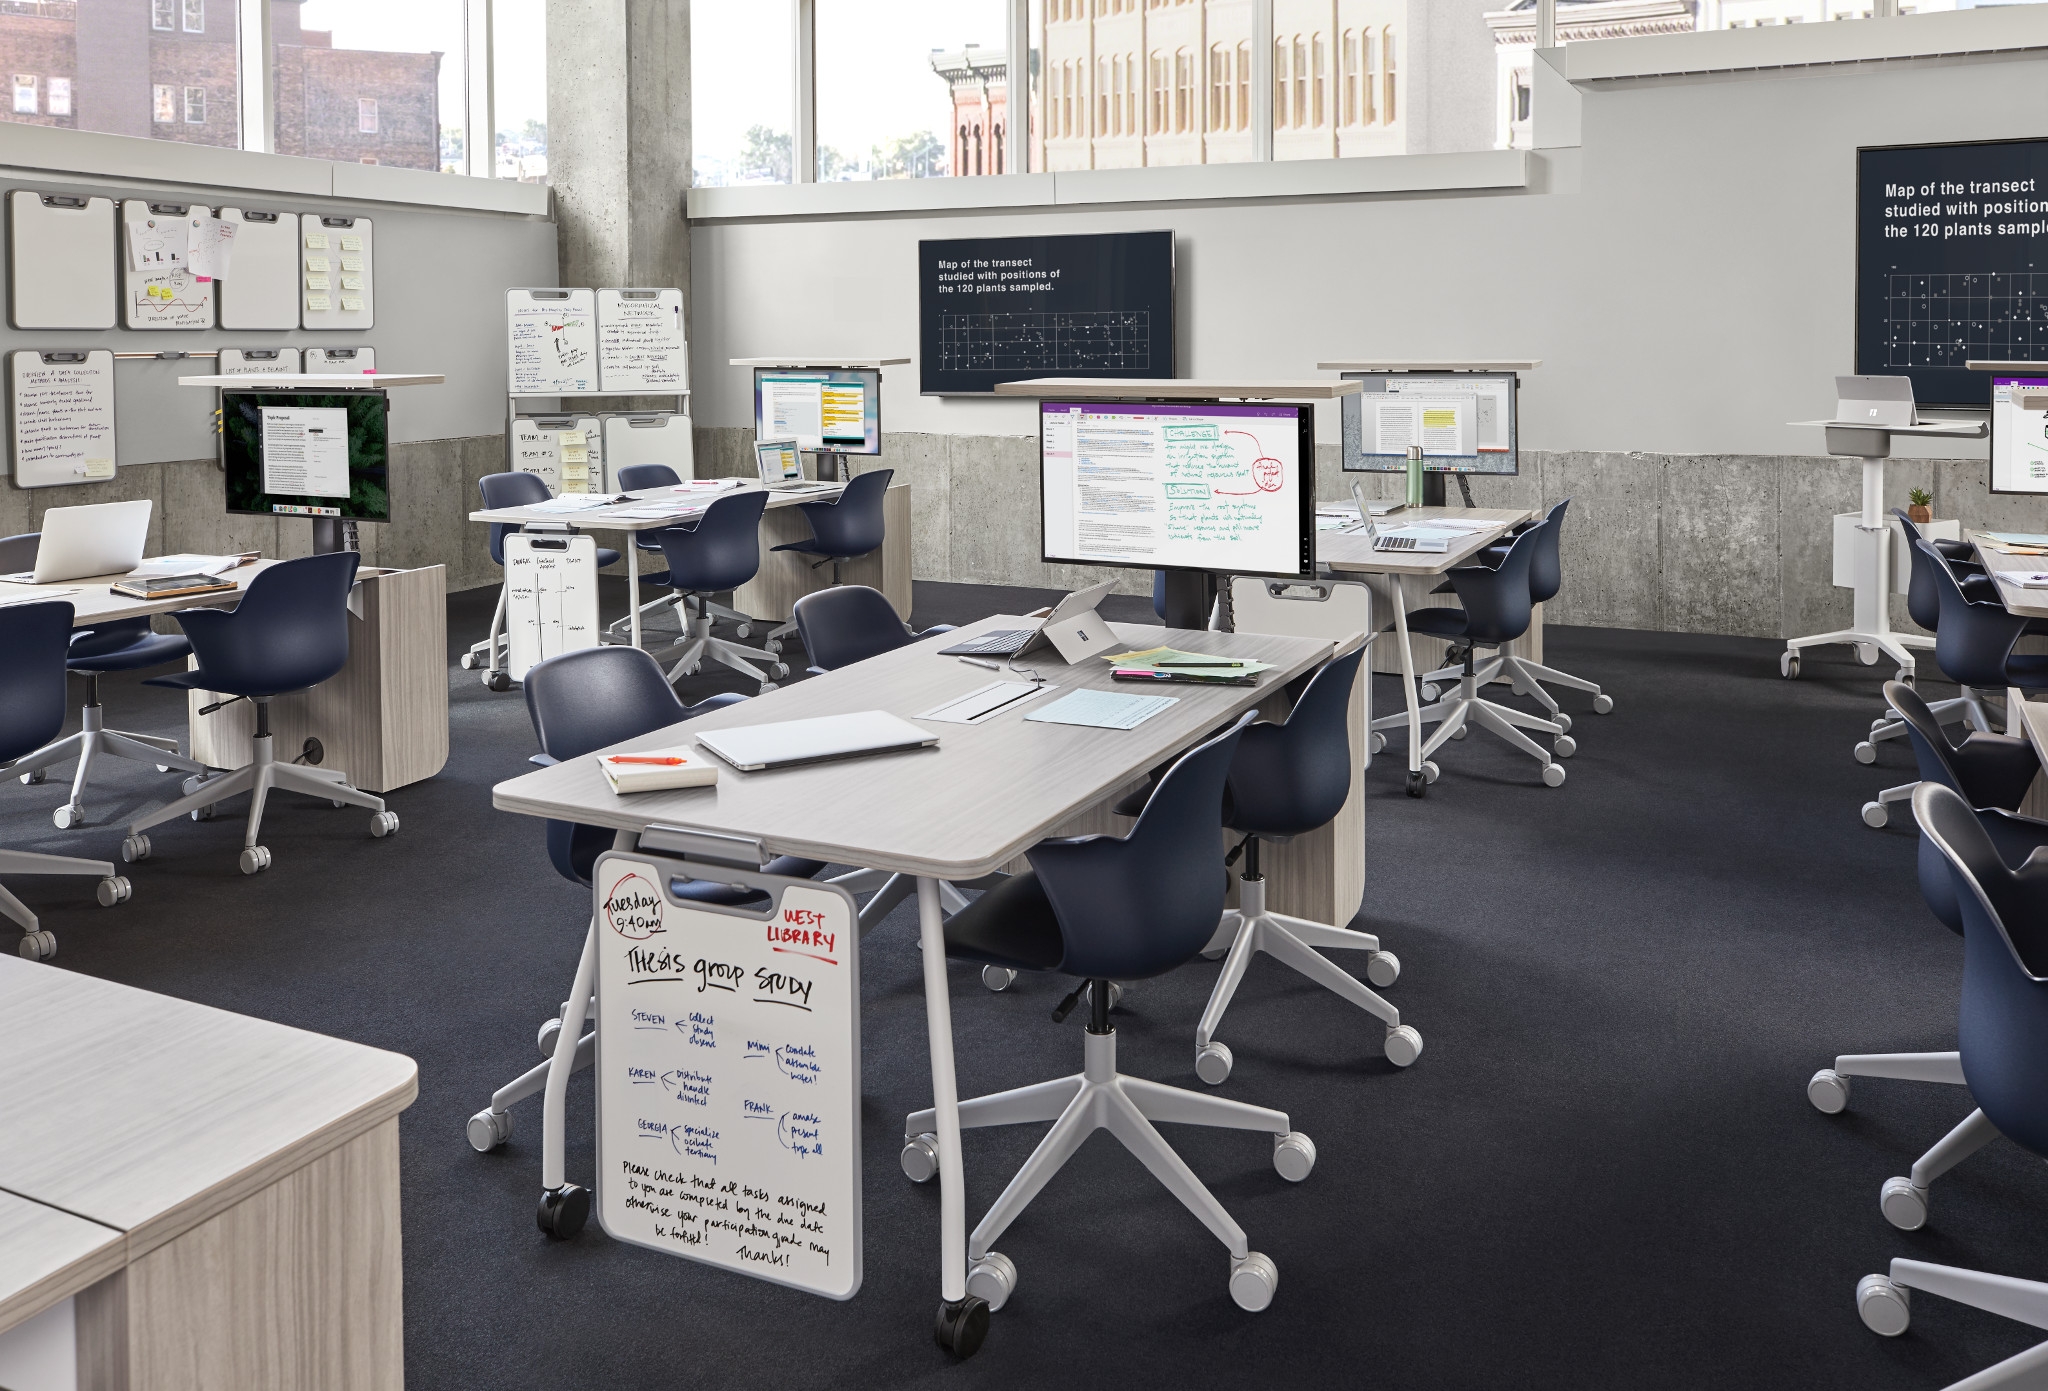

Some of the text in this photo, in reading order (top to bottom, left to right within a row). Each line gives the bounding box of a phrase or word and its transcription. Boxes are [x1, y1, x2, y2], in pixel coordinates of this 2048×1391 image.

[1885, 178, 2036, 199] Map of the transect
[1885, 202, 1941, 218] studied
[1946, 201, 1978, 215] with
[1885, 219, 2048, 239] the 120 plants sampl
[938, 258, 1032, 271] Map of the transect
[938, 269, 1061, 281] studied with positions of
[938, 282, 1055, 295] the 120 plants sampled.
[1169, 429, 1213, 438] CHALLENGE
[603, 892, 661, 915] Tuesday
[784, 909, 825, 929] WEST
[767, 925, 835, 953] LIBRARY
[693, 958, 745, 993] group
[631, 1008, 665, 1025] STEVEN
[628, 1066, 656, 1079] KAREN
[744, 1099, 774, 1113] FRANK
[638, 1117, 668, 1135] GEORGIA
[622, 1160, 828, 1216] Please check that all tasks assigned
[628, 1177, 824, 1234] to you are completed by the due date
[625, 1197, 830, 1267] otherwise your participation grade may
[655, 1223, 666, 1237] be
[736, 1245, 791, 1268] Thanks!
